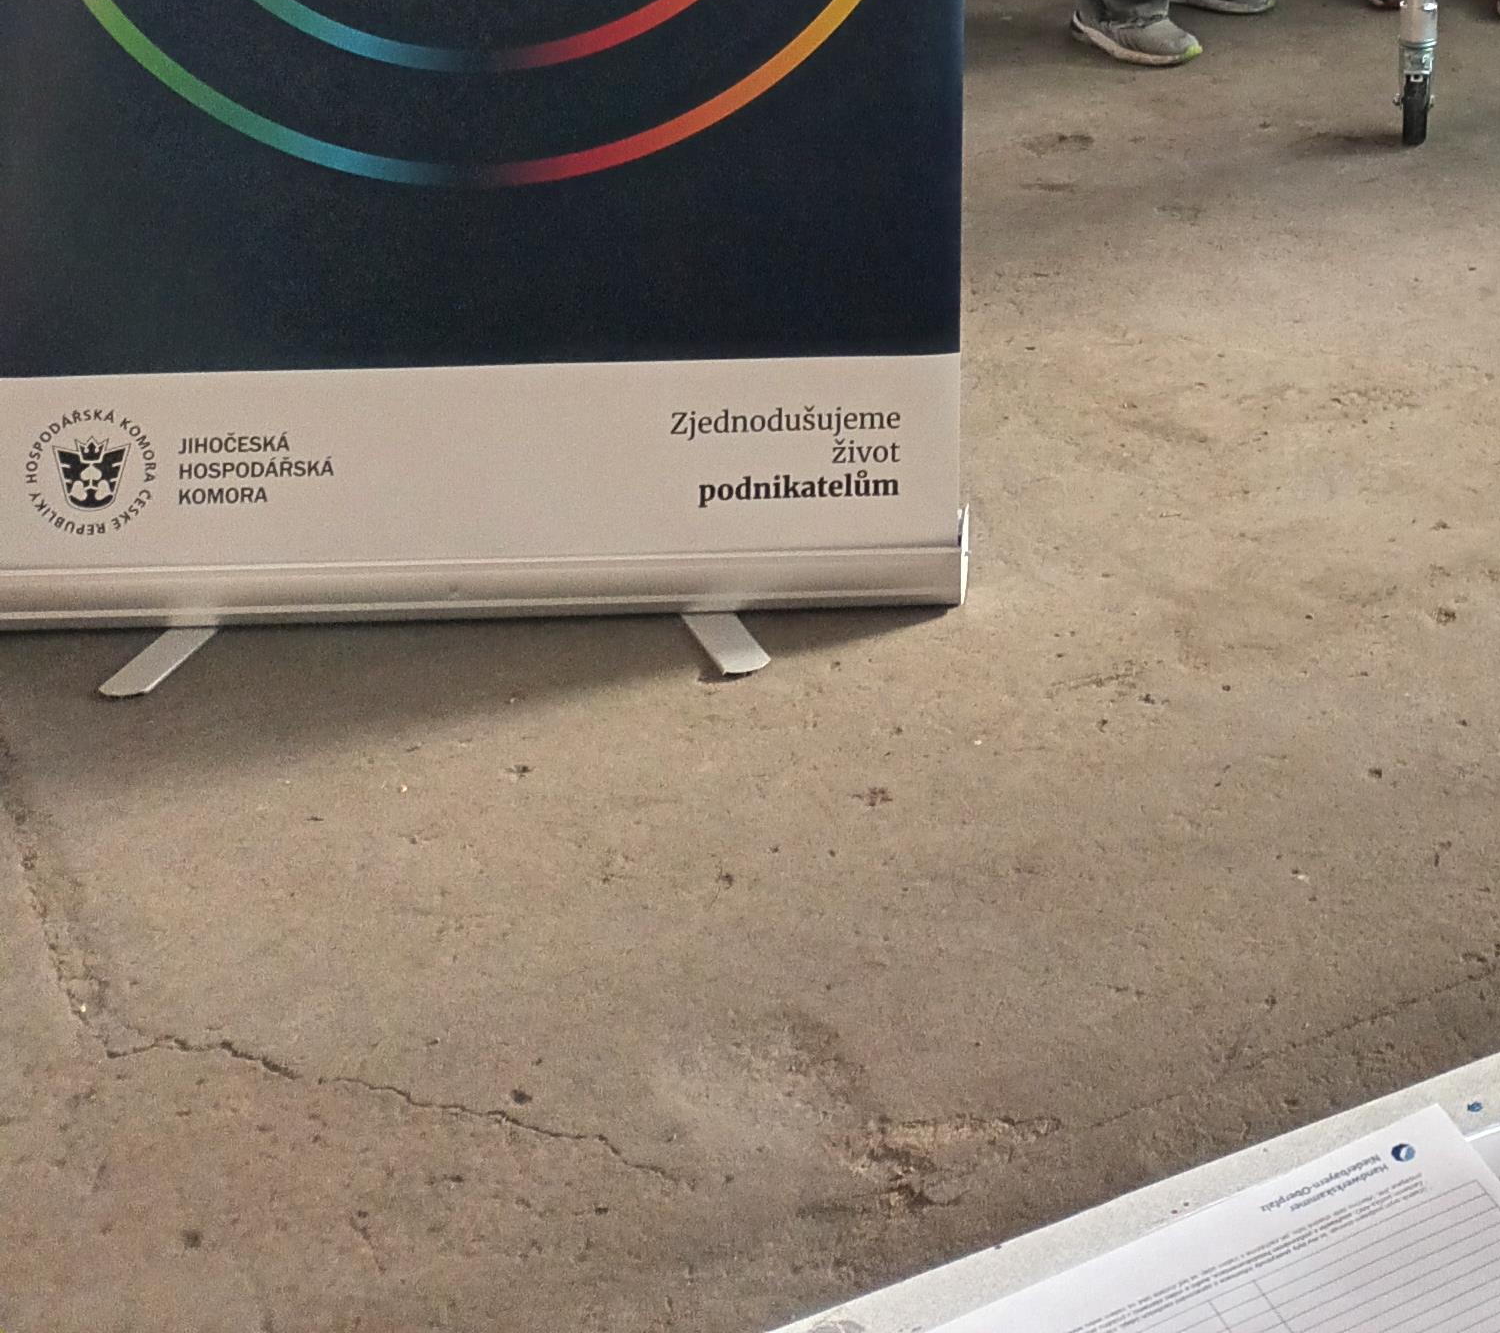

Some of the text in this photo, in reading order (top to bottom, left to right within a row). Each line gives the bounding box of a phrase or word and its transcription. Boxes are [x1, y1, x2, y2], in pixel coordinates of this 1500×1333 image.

[670, 405, 901, 441] Zjednodušujeme
[119, 417, 157, 484] KOMORA
[178, 432, 290, 455] JIHOČESKÁ
[832, 438, 901, 464] život
[178, 456, 334, 480] HOSPODÁŘSKÁ
[178, 486, 268, 505] KOMORA
[698, 469, 899, 508] podnikatelům
[28, 492, 107, 536] REPUBLIKY
[1260, 1154, 1383, 1213] Niederbayern-Oberpfalz
[1289, 1163, 1389, 1213] Handwerkskammer
